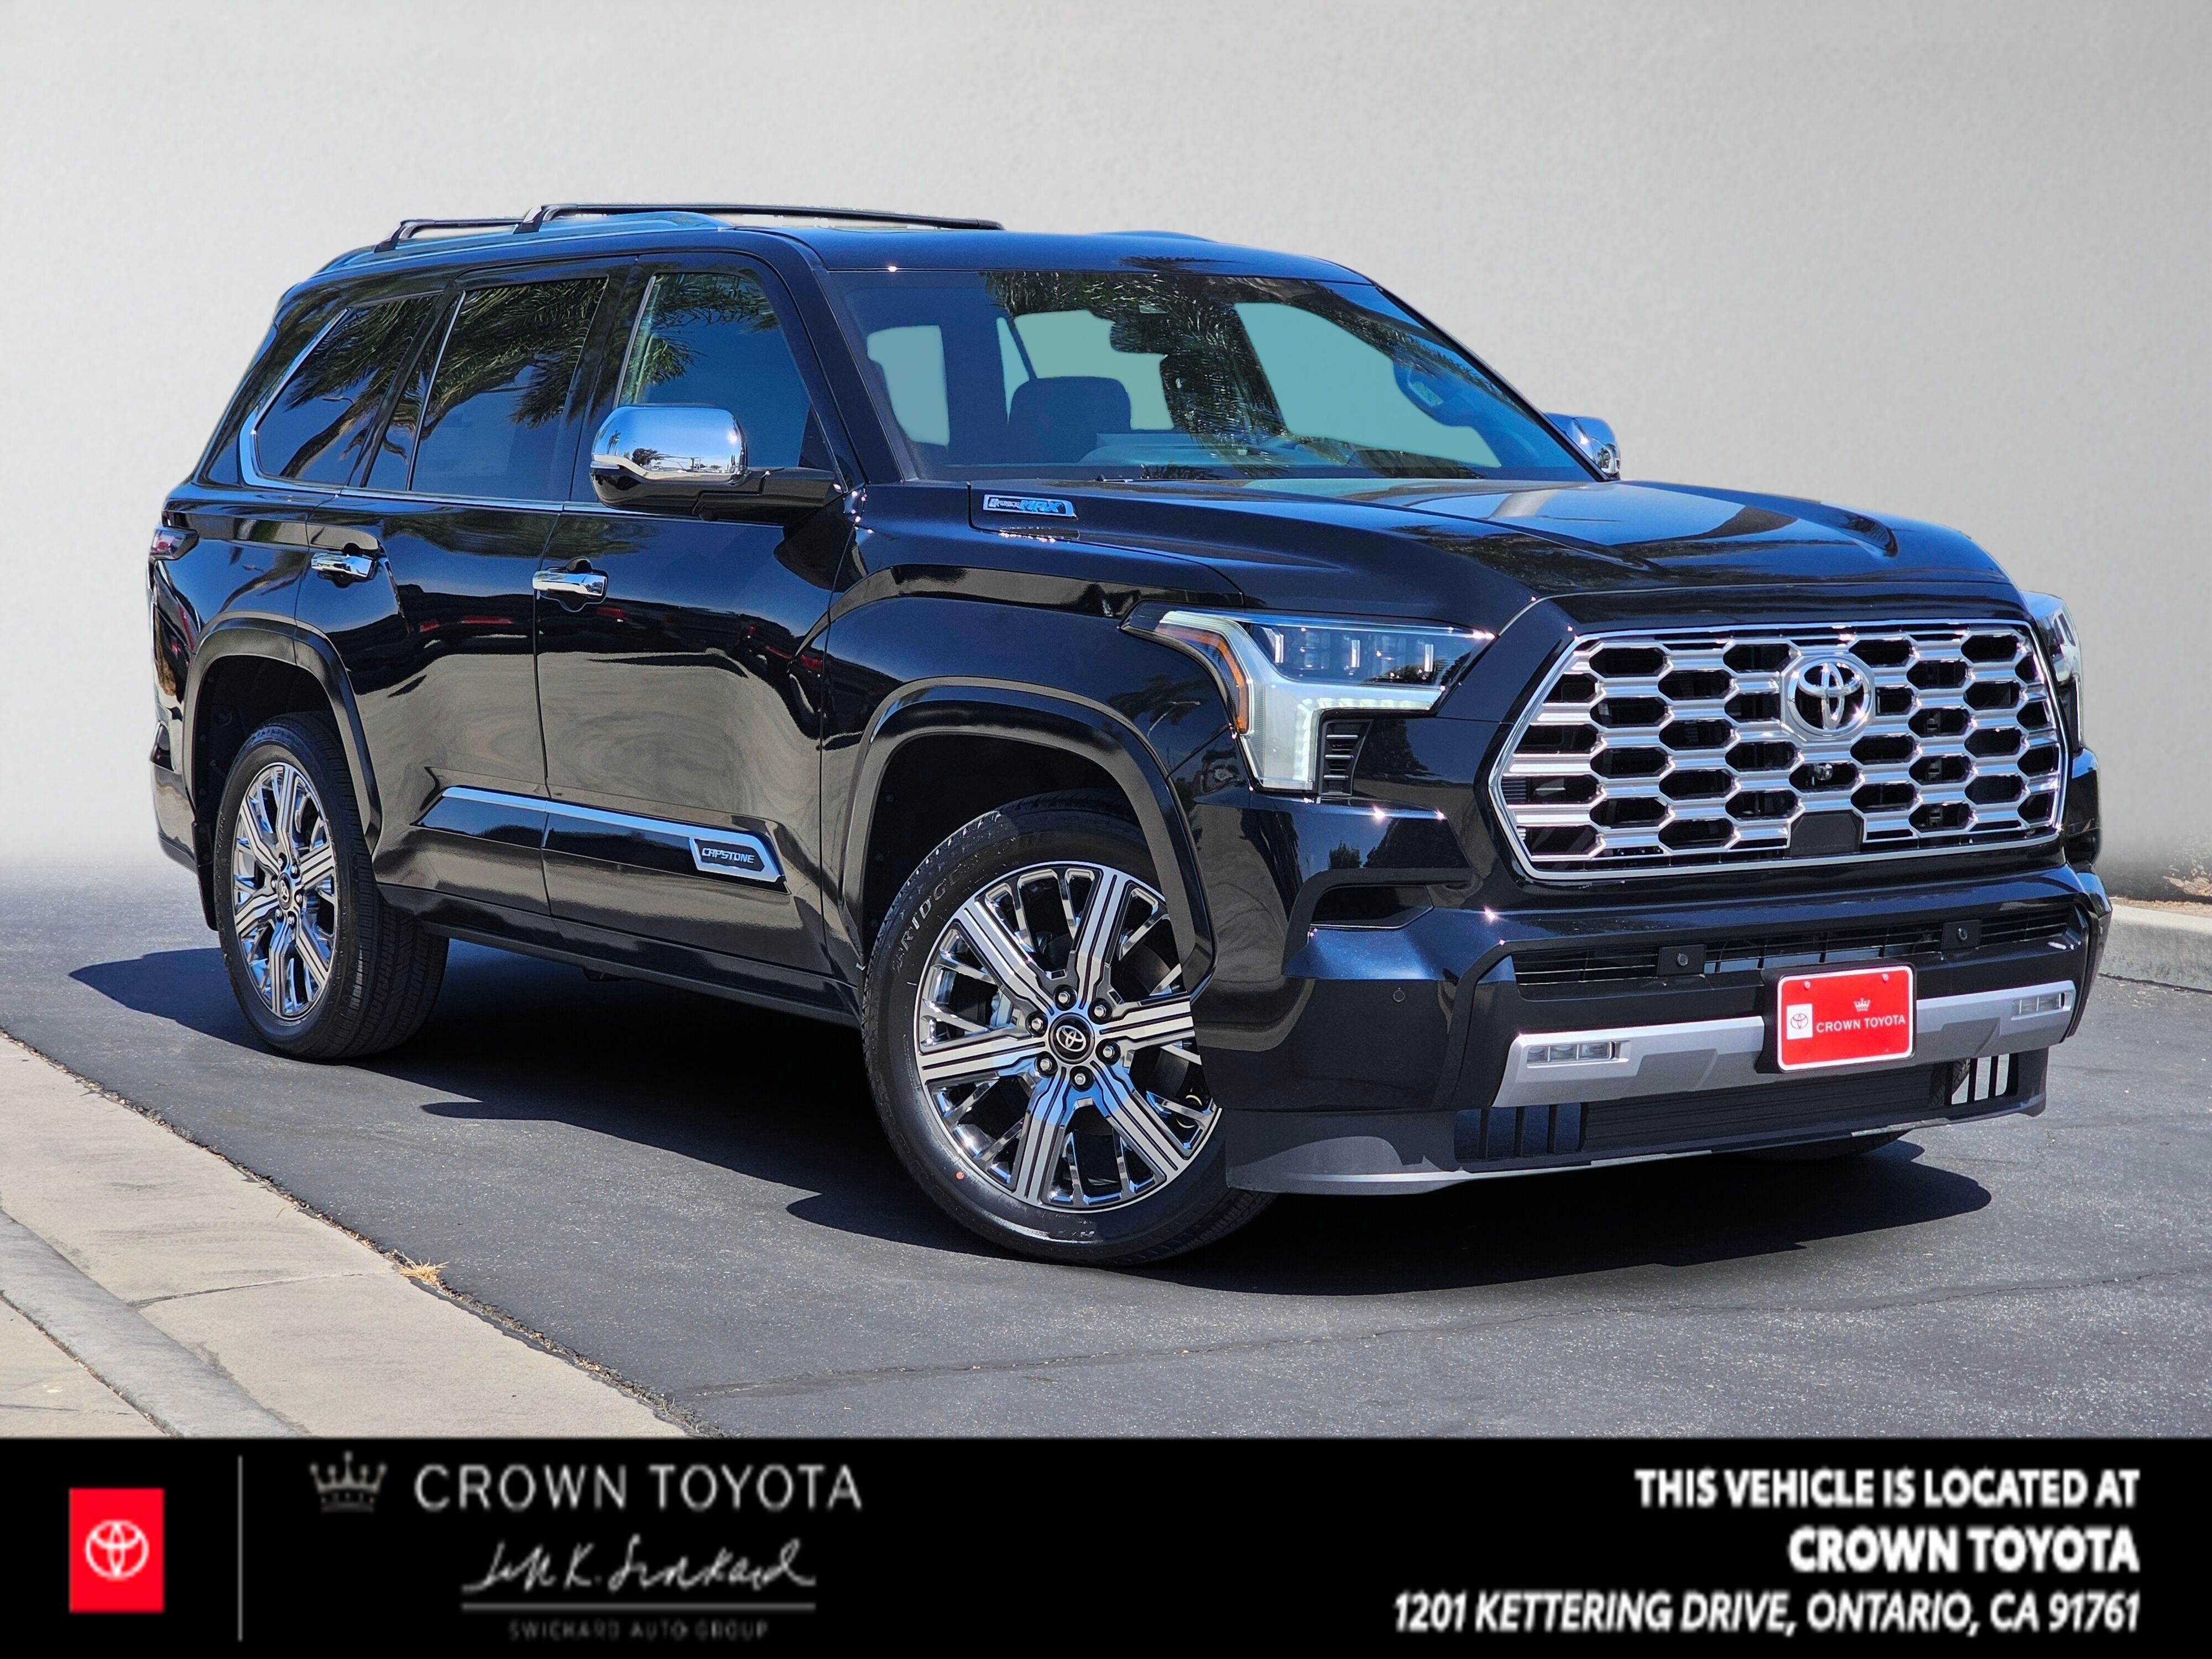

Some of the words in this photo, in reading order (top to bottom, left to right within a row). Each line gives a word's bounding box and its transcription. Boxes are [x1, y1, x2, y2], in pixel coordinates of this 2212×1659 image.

[701, 847, 755, 863] CAPSTONE
[1816, 1019, 1860, 1033] CROWN
[1864, 1014, 1906, 1028] TOYOTA
